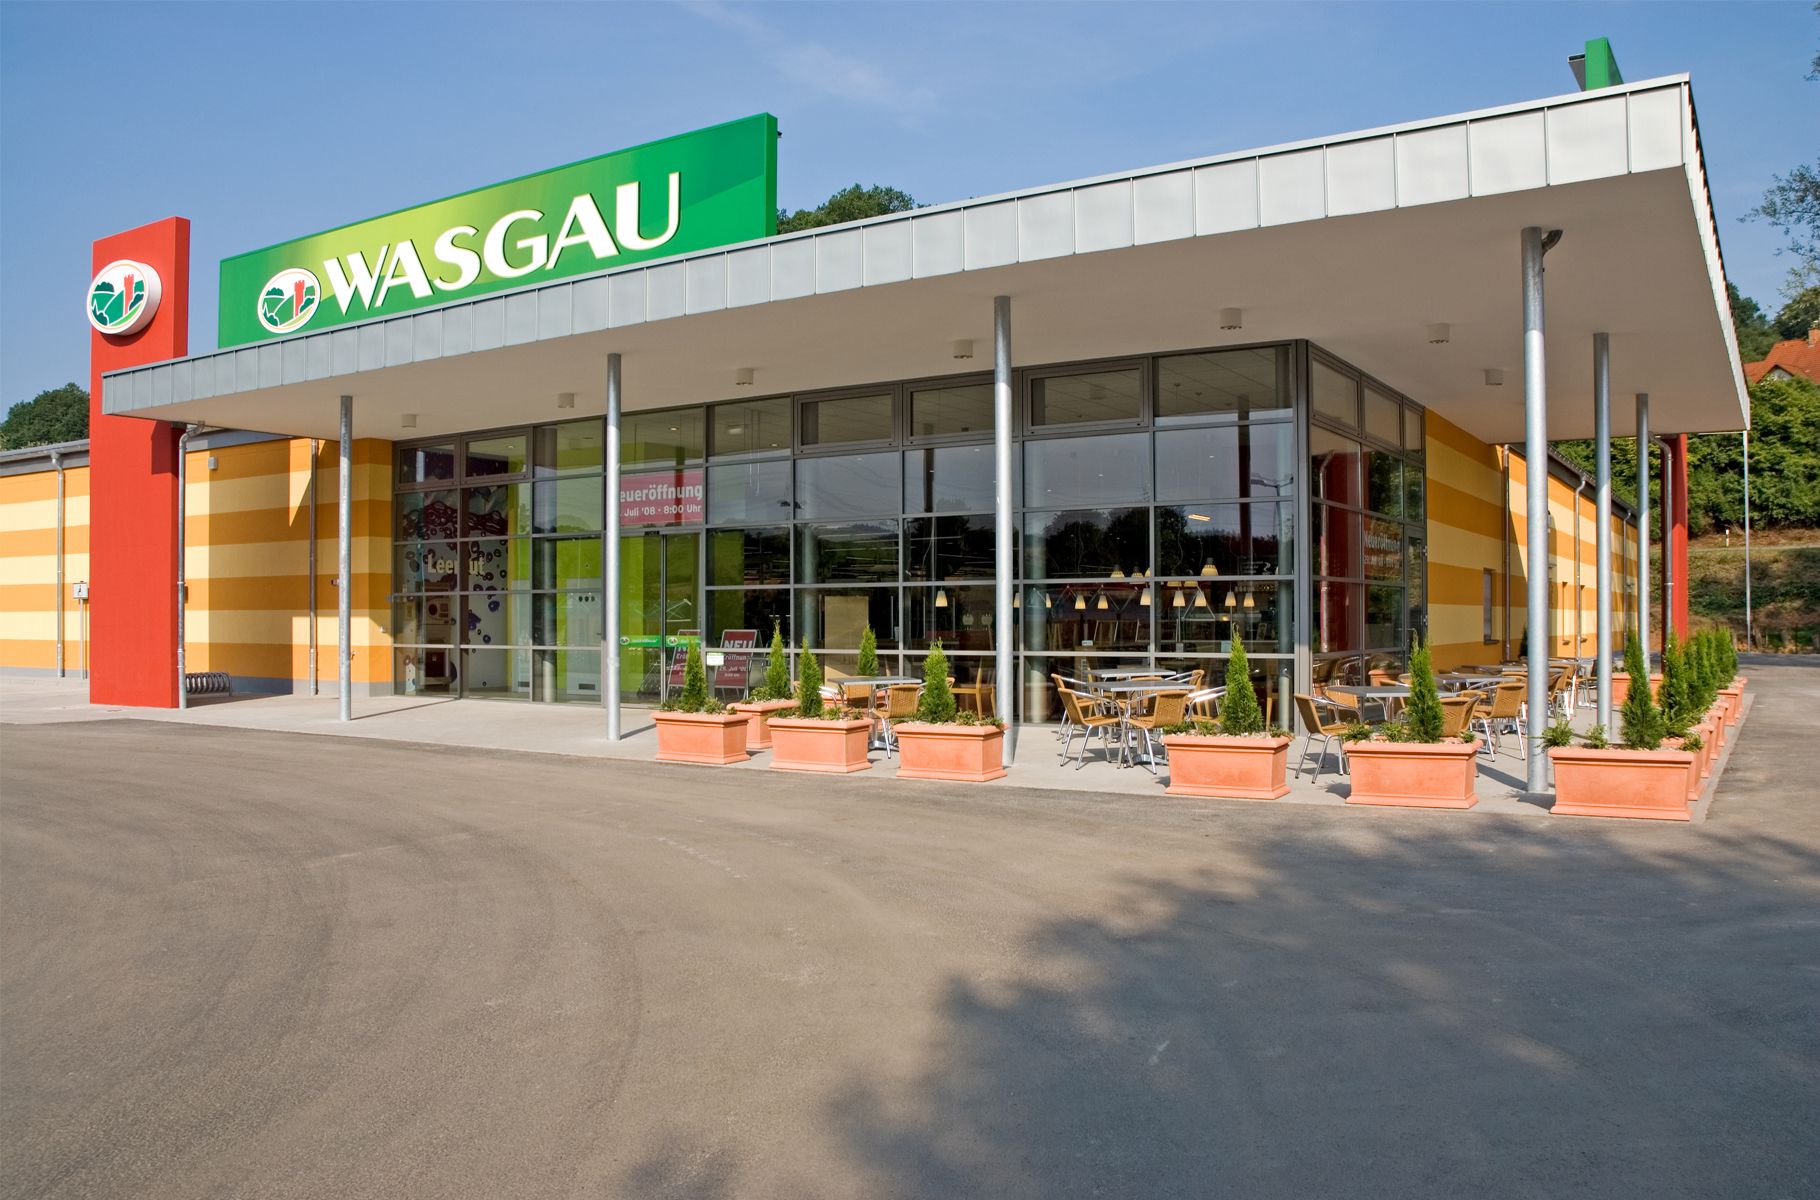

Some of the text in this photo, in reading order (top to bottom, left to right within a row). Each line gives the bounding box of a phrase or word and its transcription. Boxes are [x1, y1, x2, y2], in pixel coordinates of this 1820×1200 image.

[323, 171, 681, 316] WASGAU
[620, 484, 703, 502] eueröffnung
[624, 507, 639, 517] Juli
[663, 504, 685, 514] 8:00
[686, 503, 702, 513] Uhr
[427, 553, 485, 576] Leerut
